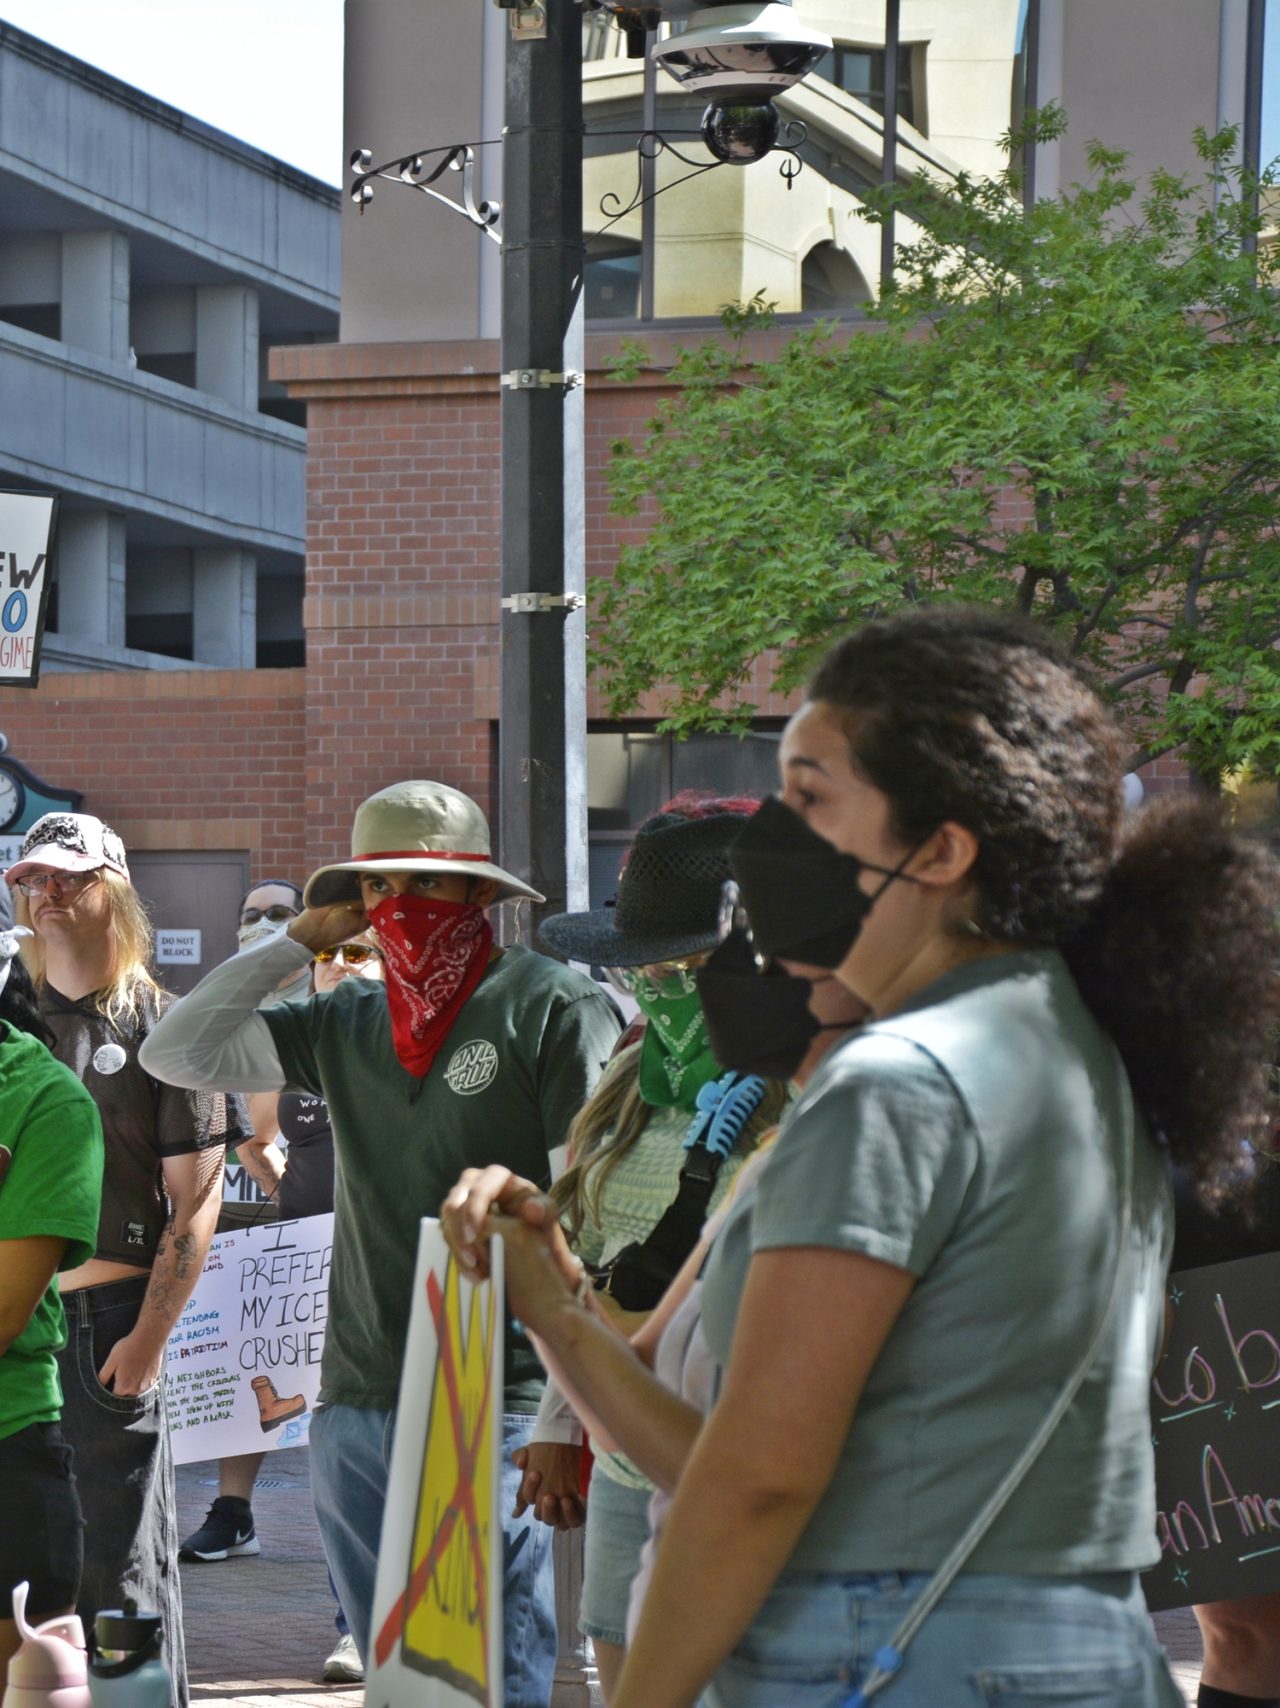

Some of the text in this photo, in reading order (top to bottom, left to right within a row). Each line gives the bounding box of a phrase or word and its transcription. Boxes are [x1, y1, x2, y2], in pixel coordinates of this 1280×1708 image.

[161, 936, 195, 945] DO NOT
[163, 948, 194, 957] BLOCK
[262, 1221, 299, 1252] I
[224, 1240, 235, 1248] IS
[203, 1263, 224, 1272] LAND
[240, 1290, 329, 1331] MY ICE
[187, 1326, 219, 1339] RACISM
[181, 1341, 228, 1358] PATRIOTISM
[239, 1331, 325, 1371] CRUSHE
[177, 1367, 226, 1383] NEIGHBORS
[186, 1418, 200, 1428] AND
